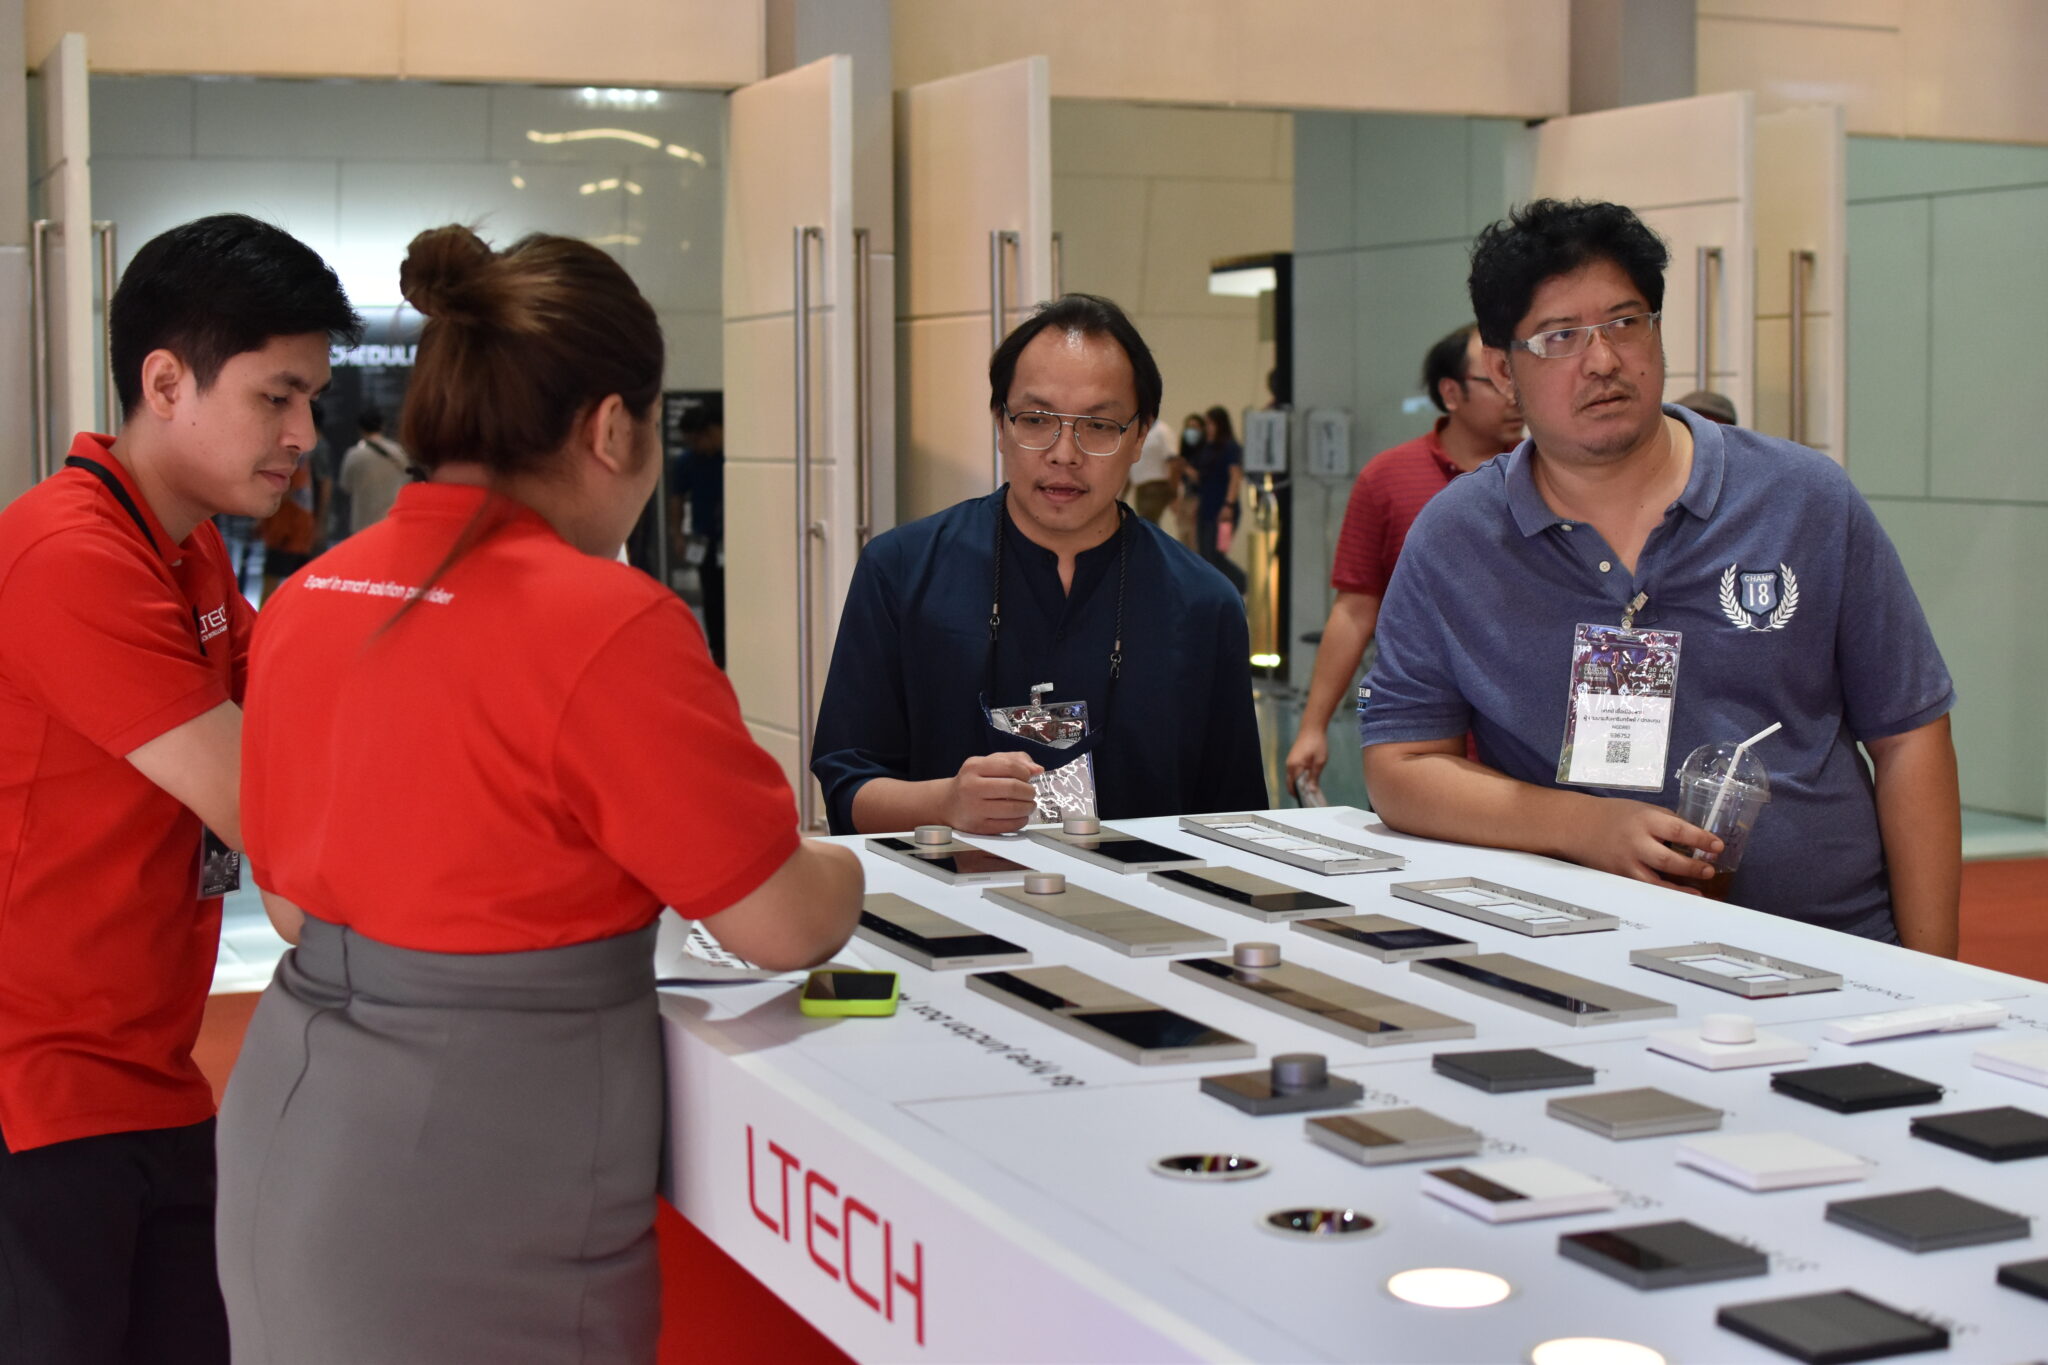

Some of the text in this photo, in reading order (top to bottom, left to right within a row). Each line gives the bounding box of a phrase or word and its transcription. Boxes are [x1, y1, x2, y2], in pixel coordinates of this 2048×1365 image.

[1744, 574, 1774, 582] CHAMP
[1749, 583, 1769, 607] 18
[746, 1123, 924, 1347] LTECH
